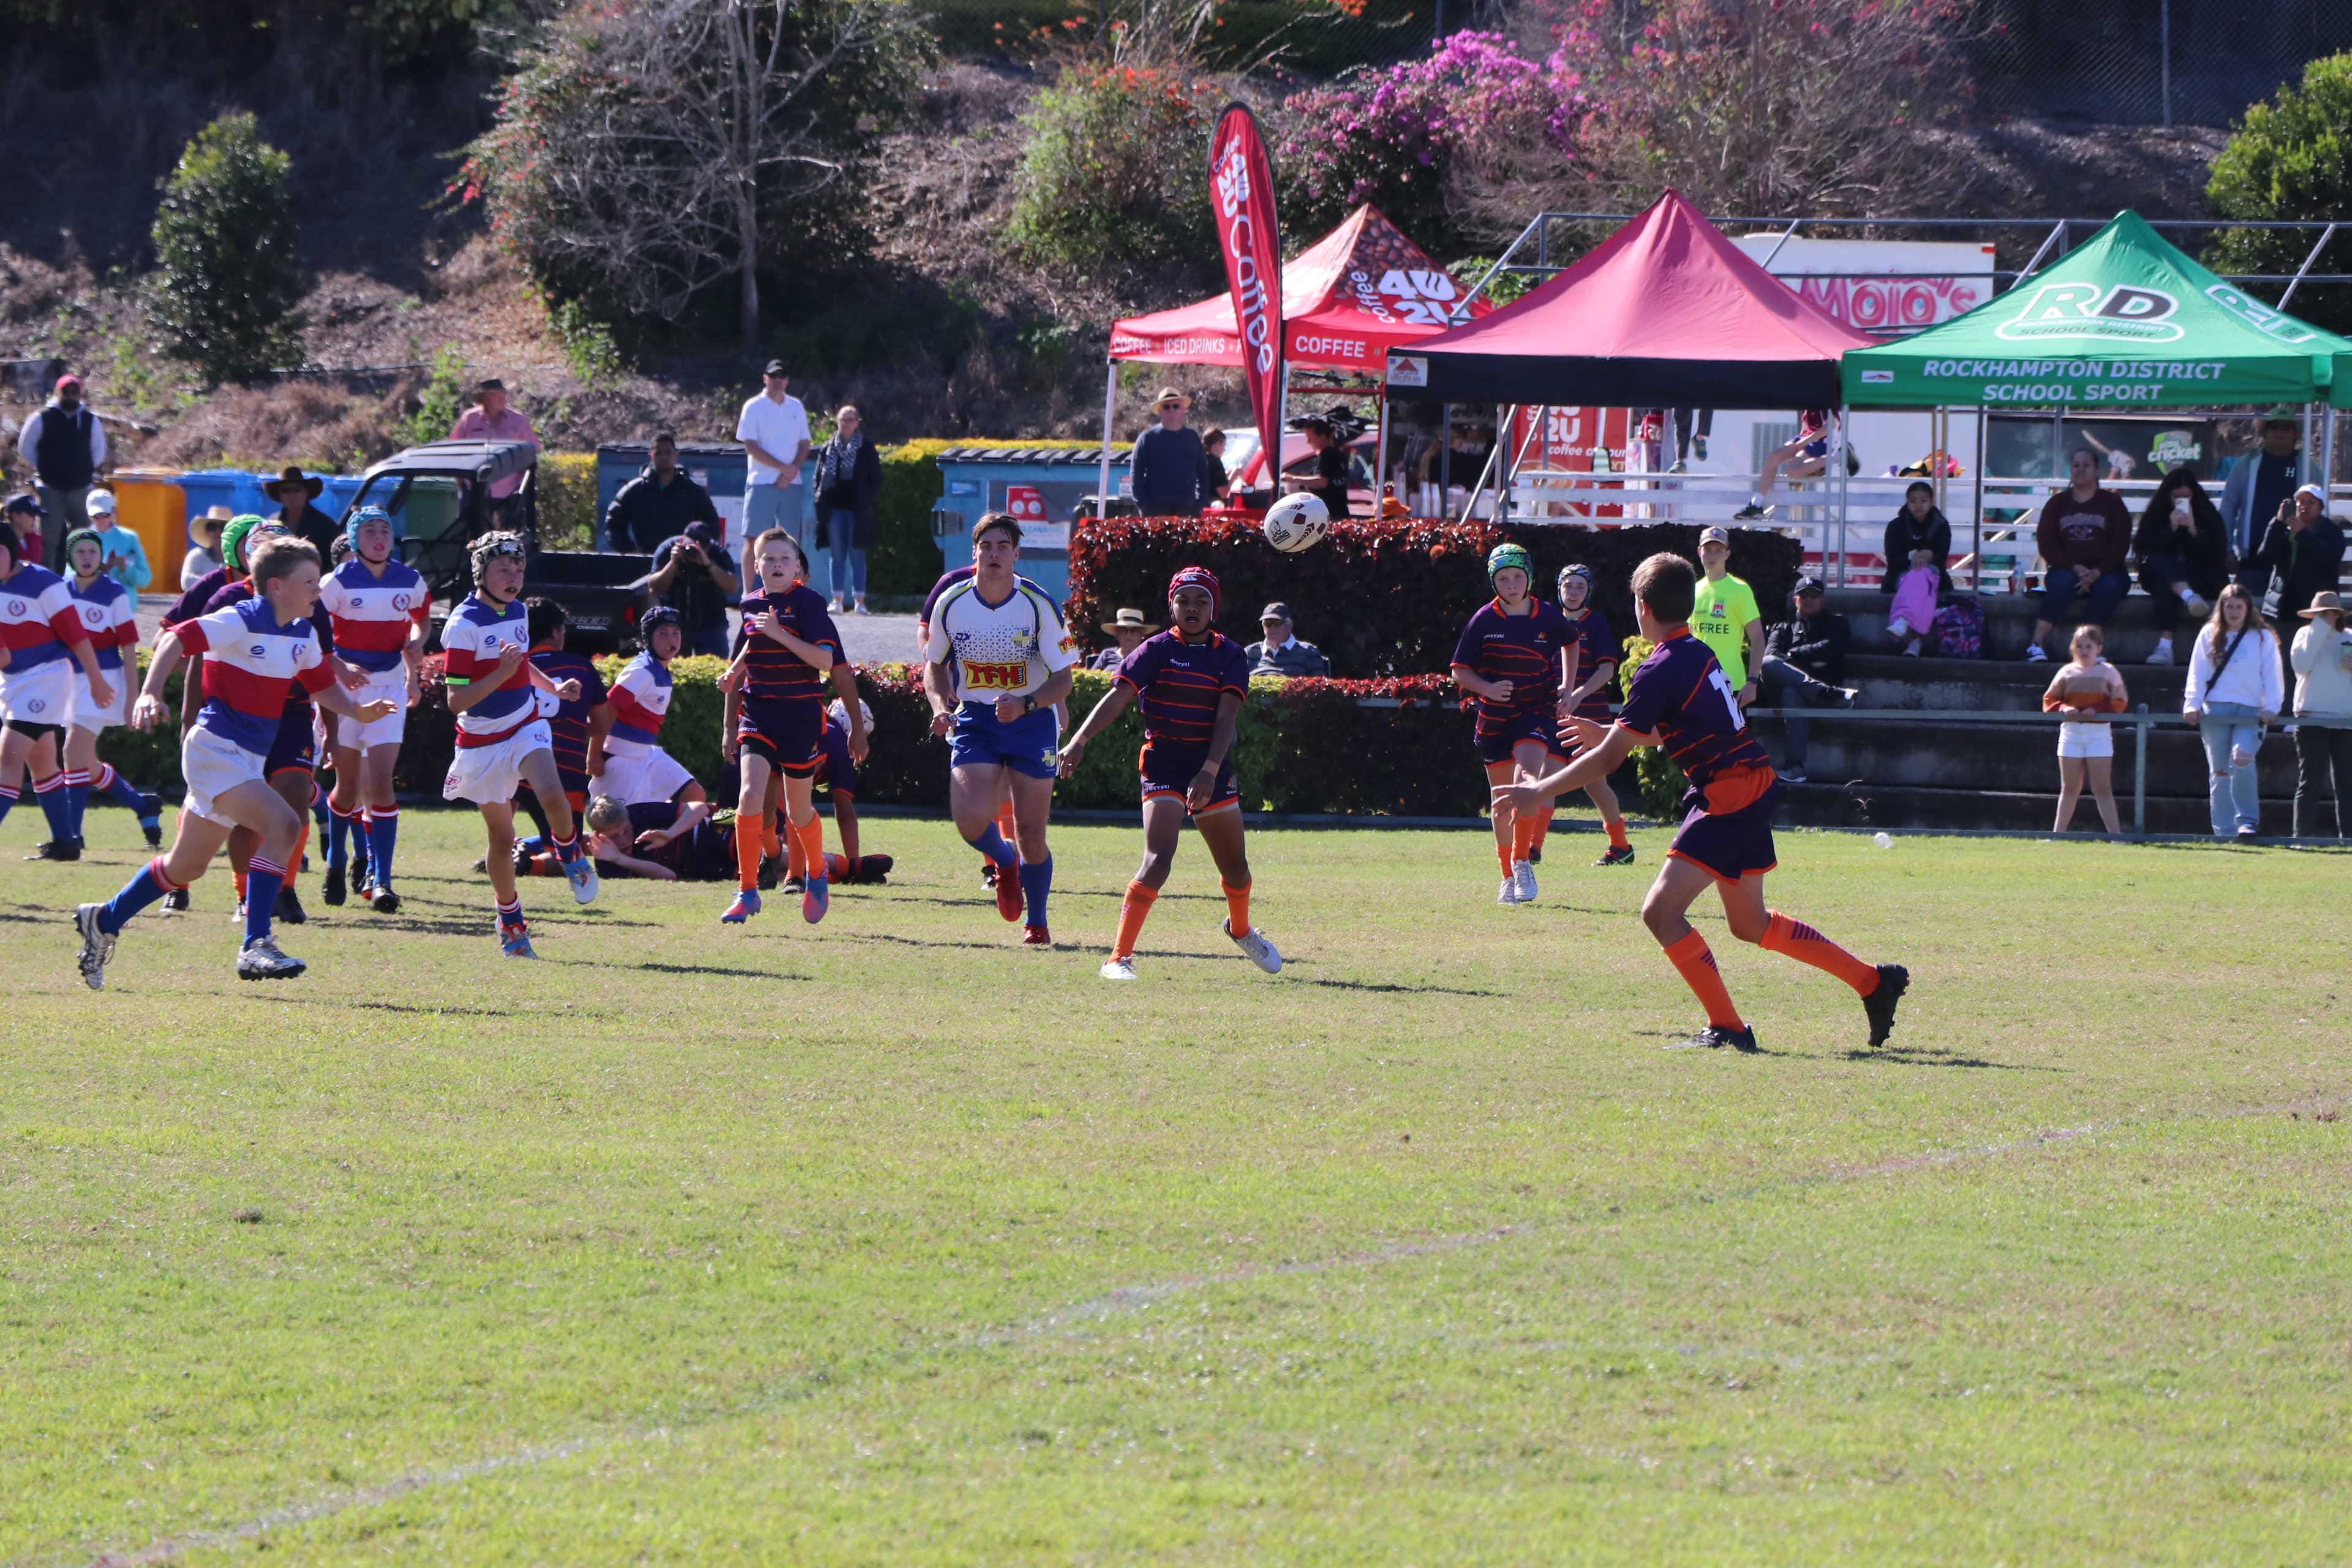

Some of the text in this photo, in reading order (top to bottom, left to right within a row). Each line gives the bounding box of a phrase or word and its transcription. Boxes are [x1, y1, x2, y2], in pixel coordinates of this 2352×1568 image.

[1351, 270, 1396, 323] coffee
[2020, 326, 2156, 337] SCHOOL SPORT
[1113, 337, 1152, 353] COFFEE
[1164, 339, 1187, 353] ICED
[1188, 338, 1225, 354] DRINKS
[1295, 336, 1366, 358] COFFEE
[1923, 360, 2225, 379] ROCKHAMPTON DISTRICT
[1982, 384, 2163, 401] SCHOOL SPORT
[1548, 443, 1583, 455] coffee
[2147, 442, 2201, 462] cricket
[967, 663, 1019, 686] TFH
